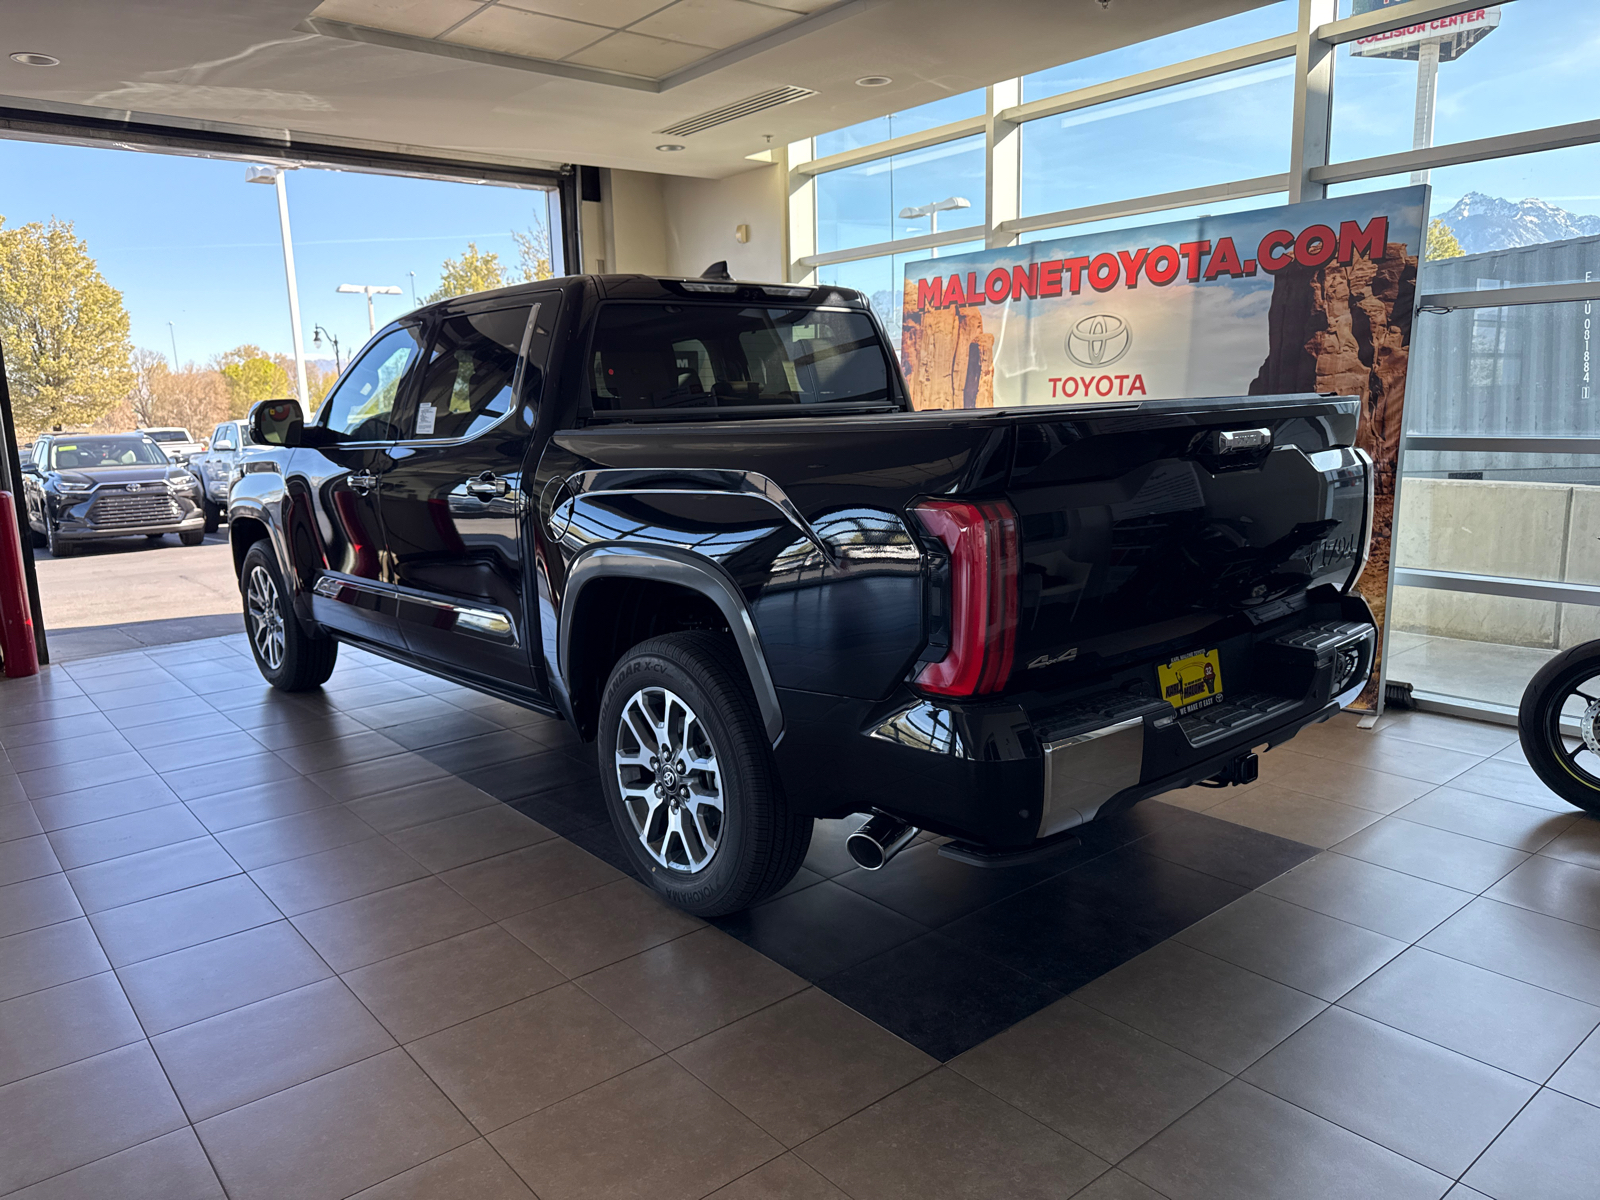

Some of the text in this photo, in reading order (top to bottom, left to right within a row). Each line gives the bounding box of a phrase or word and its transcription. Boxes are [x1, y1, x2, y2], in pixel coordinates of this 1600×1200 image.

[1356, 9, 1486, 45] COLLISION CENTER
[917, 216, 1390, 310] MALONETOYOTA.COM
[1048, 374, 1147, 398] TOYOTA
[1205, 666, 1213, 676] 32
[1179, 706, 1187, 716] WE
[1187, 702, 1198, 713] MAKE
[1203, 697, 1214, 707] EASY
[665, 883, 717, 903] YOKOHAMA
